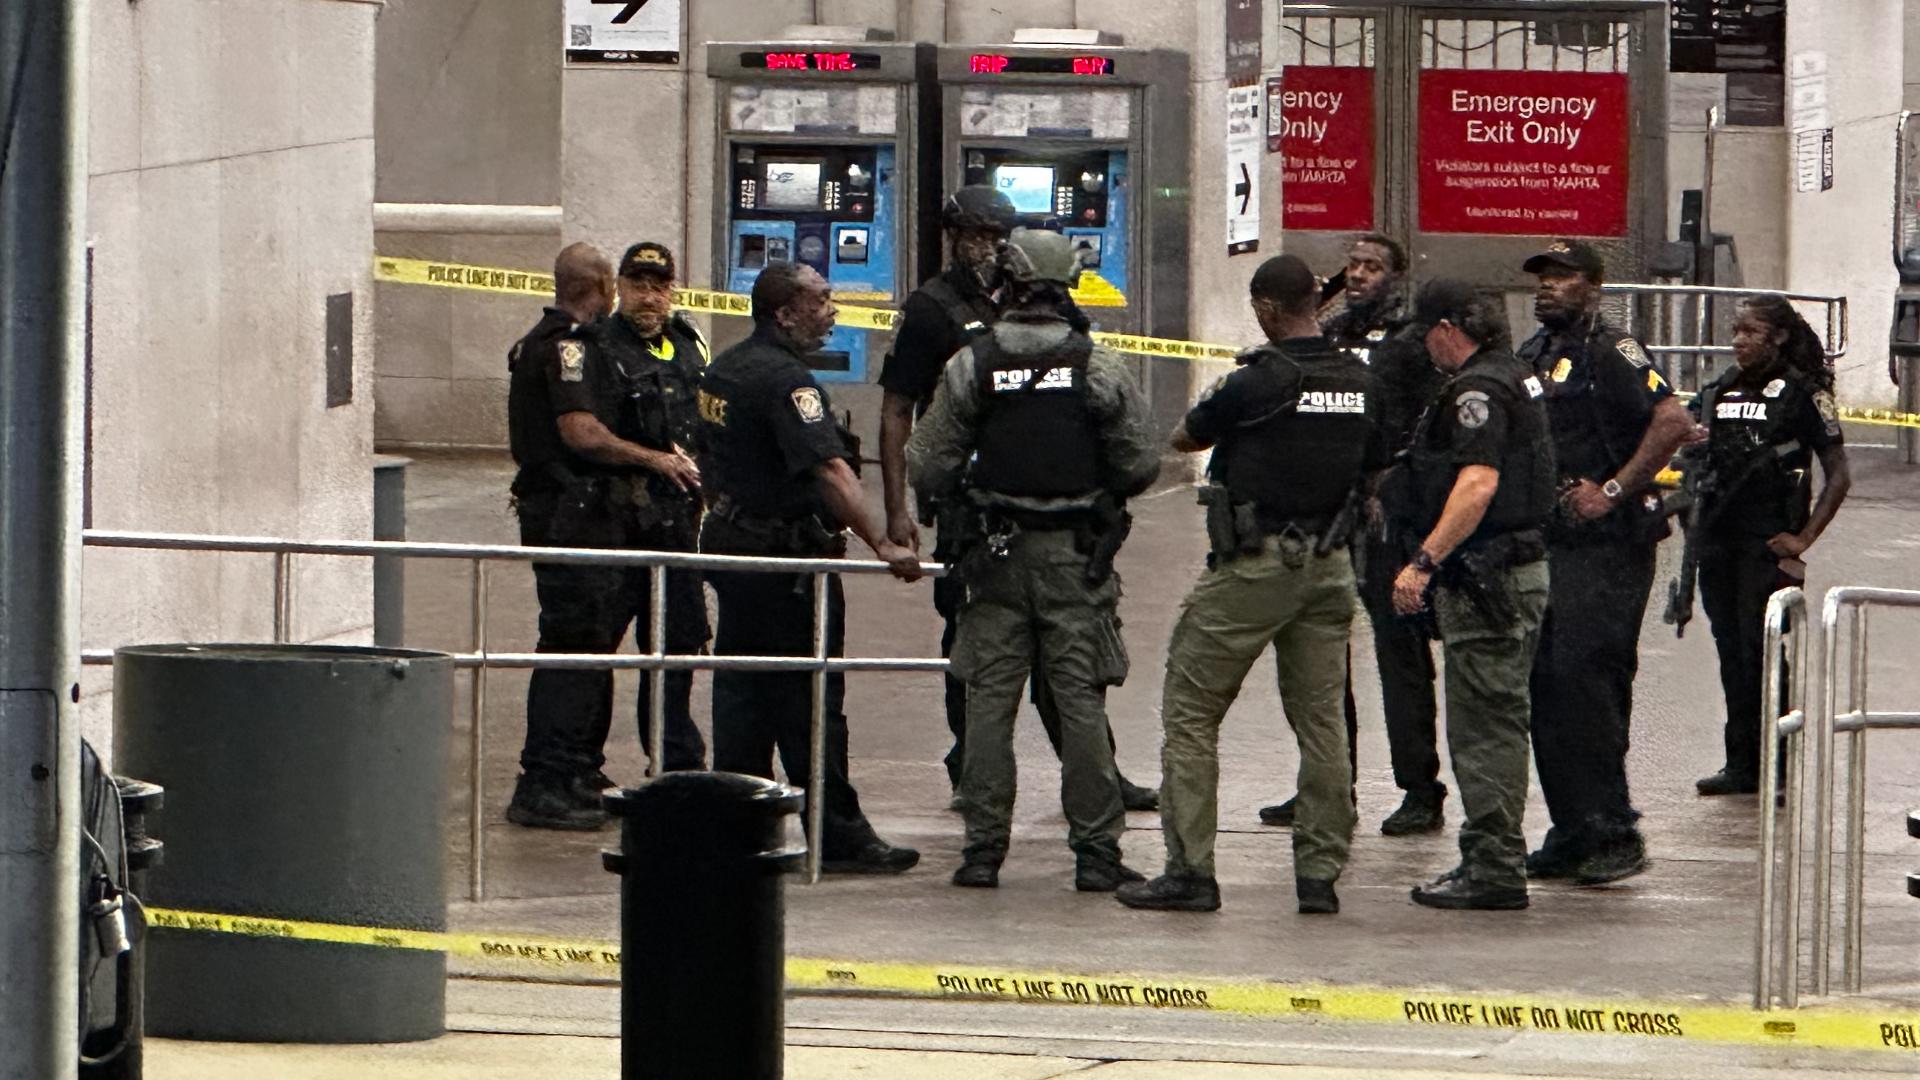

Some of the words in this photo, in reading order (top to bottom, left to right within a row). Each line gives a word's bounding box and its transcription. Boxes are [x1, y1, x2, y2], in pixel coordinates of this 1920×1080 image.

[1451, 89, 1597, 120] Emergency
[1467, 119, 1515, 143] Exit
[1522, 120, 1581, 150] Only
[428, 264, 463, 284] POLICE
[466, 268, 490, 287] LINE
[490, 270, 505, 289] DO
[507, 272, 529, 291] NOT
[993, 367, 1073, 385] POLCE
[1299, 391, 1365, 407] POLICE
[937, 974, 1006, 994] POLICE
[1012, 979, 1055, 1000] LINE
[1062, 982, 1090, 1004] DO
[1095, 984, 1135, 1007] NOT
[1142, 986, 1211, 1010] CROSS
[1404, 1001, 1473, 1025] POLICE
[1480, 1005, 1523, 1028] LINE
[1531, 1007, 1561, 1030] DO
[1564, 1009, 1605, 1033] NOT
[1612, 1011, 1683, 1037] CROSS
[1880, 1021, 1920, 1049] POL
